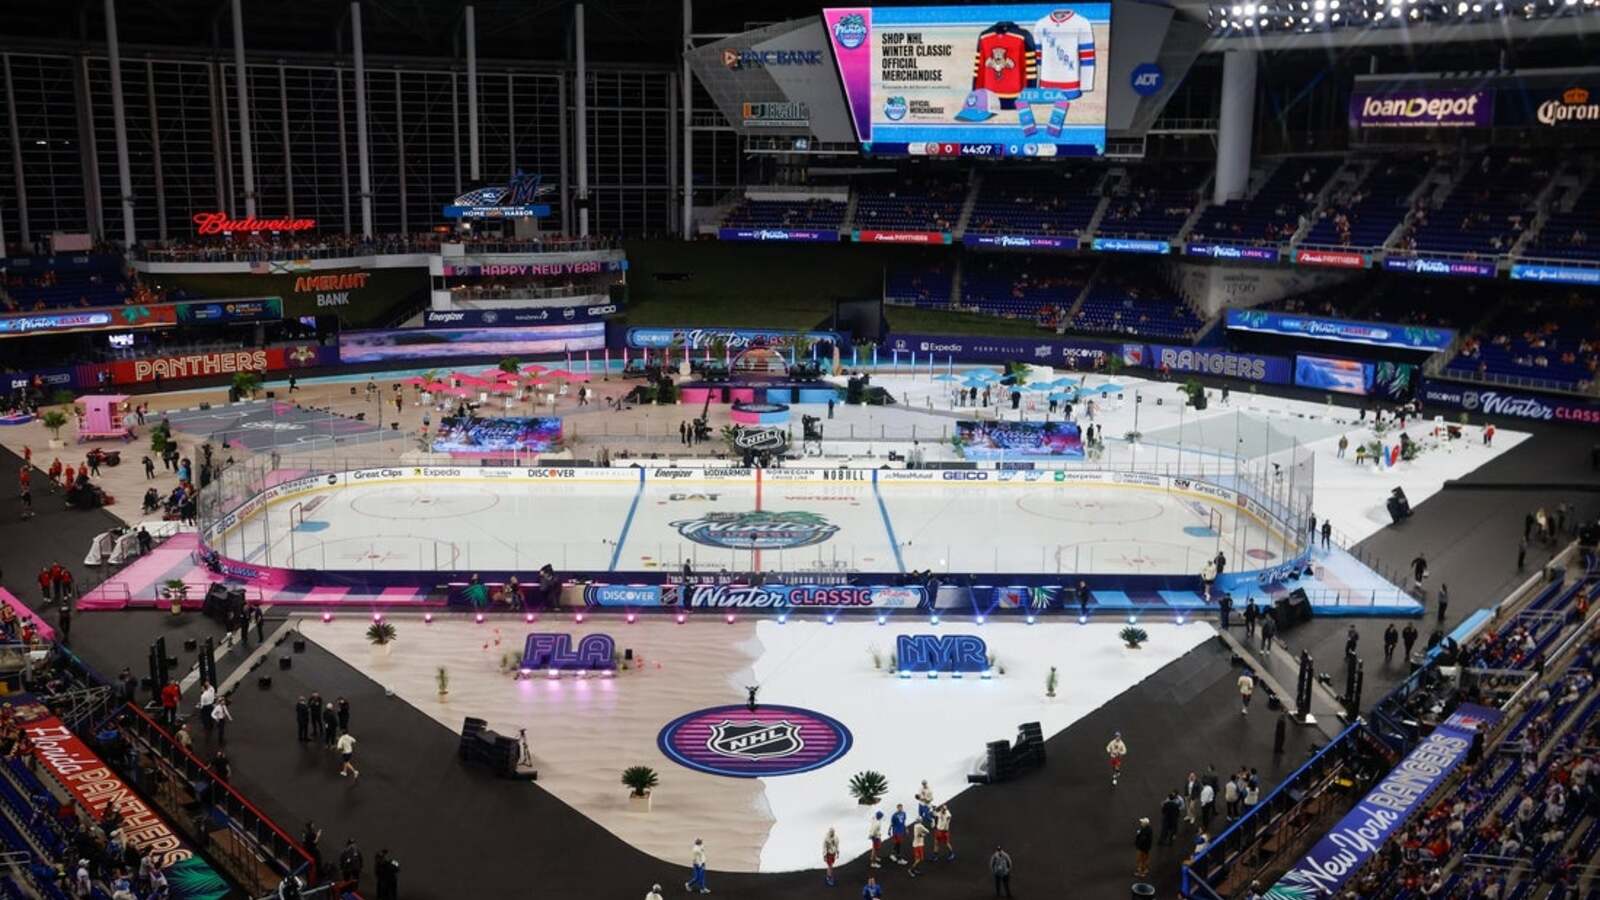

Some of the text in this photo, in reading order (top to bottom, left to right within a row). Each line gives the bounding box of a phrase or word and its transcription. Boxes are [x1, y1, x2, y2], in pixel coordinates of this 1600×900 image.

[882, 33, 924, 44] SHOP NHL
[882, 44, 953, 57] WINTER CLASSIC
[882, 58, 918, 69] OFFICIAL
[882, 69, 943, 81] MERCHANDISE
[1133, 73, 1160, 86] ADT
[1362, 94, 1478, 120] loanDepot
[945, 145, 1018, 154] 0 44:07 0
[193, 212, 317, 235] Budweiser
[480, 261, 601, 276] HAPPY NEW YEAR!
[294, 272, 368, 293] AMERANT
[316, 292, 350, 306] BANK
[428, 312, 464, 322] Energizer
[588, 304, 617, 315] GEICO
[635, 333, 670, 342] DISCOVER
[930, 342, 962, 352] Expedia
[135, 350, 268, 382] PANTHERS
[1161, 347, 1266, 380] RANGERS
[1426, 391, 1461, 403] DISCOVER
[1480, 391, 1553, 420] Winter
[353, 468, 403, 480] Great Clips
[423, 468, 461, 478] Expedia
[528, 468, 575, 478] DISCOVER
[654, 469, 693, 479] Energizer
[823, 470, 864, 481] NOBULL
[942, 471, 988, 481] GEICO
[602, 590, 655, 602] DISCOVER
[690, 584, 787, 609] Winter
[789, 588, 872, 606] CLASSIC
[522, 633, 617, 670] FLA
[897, 634, 990, 672] NYR
[729, 728, 785, 752] NHL
[26, 725, 193, 869] Florida PANTHERS
[1300, 733, 1469, 895] New York RANGERS
